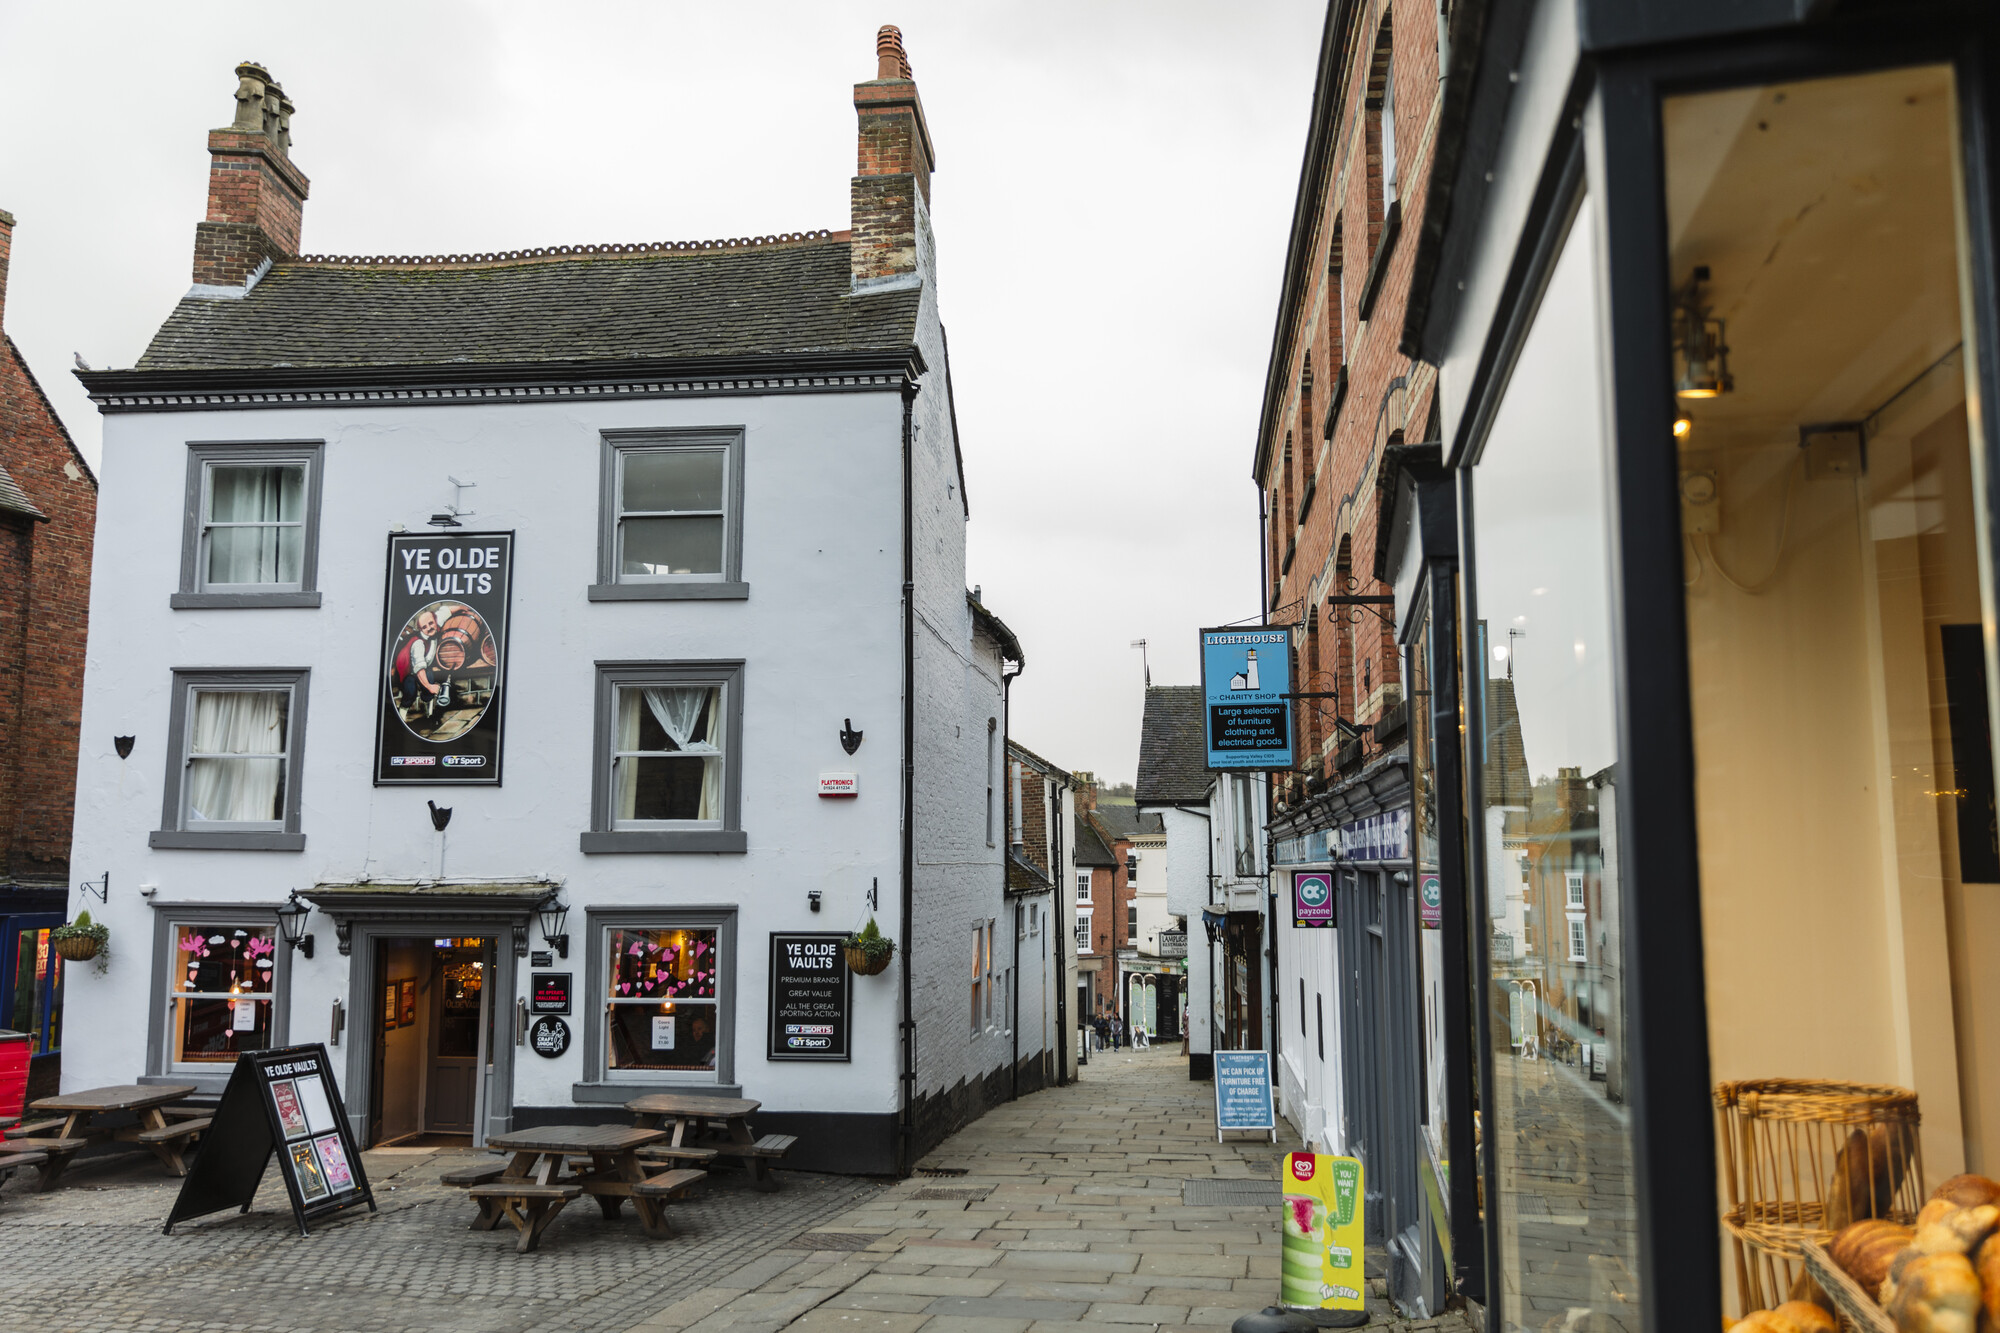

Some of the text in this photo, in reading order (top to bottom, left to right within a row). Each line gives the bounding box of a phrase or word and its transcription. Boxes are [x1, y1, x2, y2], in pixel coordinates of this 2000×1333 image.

[401, 547, 500, 570] YE OLDE
[405, 573, 492, 595] VAULTS
[1206, 634, 1286, 646] LIGHTHOUSE
[1218, 707, 1280, 716] Large selection
[1224, 728, 1257, 736] clothing
[1218, 738, 1282, 748] electrical goods
[460, 757, 482, 766] Sport
[1299, 908, 1330, 916] payzone
[786, 944, 836, 956] YE OLDE
[789, 957, 833, 969] VAULTS
[264, 1059, 318, 1078] YE OLDE VAULTS
[1231, 1068, 1242, 1076] CAN
[1243, 1068, 1256, 1076] PICK
[1257, 1067, 1265, 1075] UP
[1221, 1078, 1266, 1086] FURNITURE FREE
[1237, 1088, 1260, 1096] CHARGE
[1340, 1170, 1351, 1178] YOU
[1337, 1179, 1354, 1188] WANT
[1341, 1188, 1350, 1196] ME
